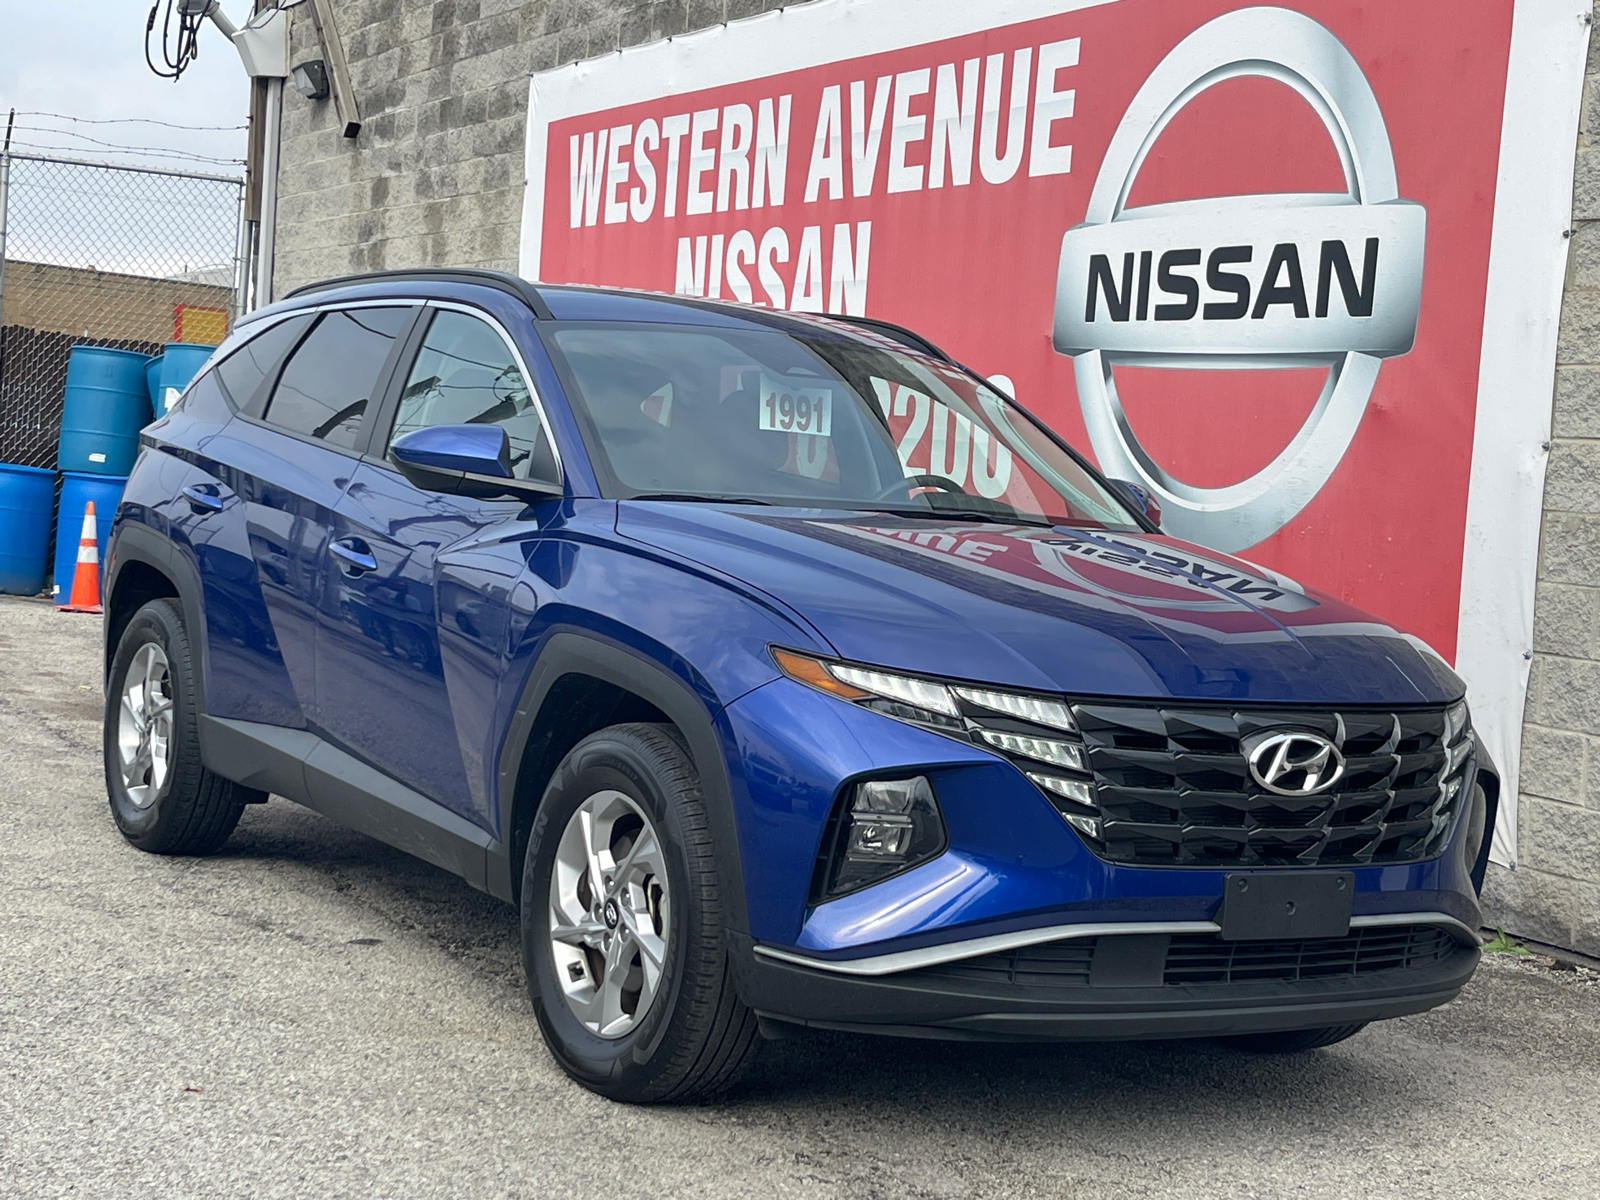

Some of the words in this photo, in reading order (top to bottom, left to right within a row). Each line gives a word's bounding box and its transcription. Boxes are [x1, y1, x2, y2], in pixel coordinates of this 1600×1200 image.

[569, 94, 792, 229] WESTERN
[803, 36, 1082, 203] AVENUE
[675, 220, 872, 317] NISSAN
[1084, 237, 1380, 323] NISSAN
[765, 392, 824, 433] 1991
[523, 811, 549, 930] NEXEN
